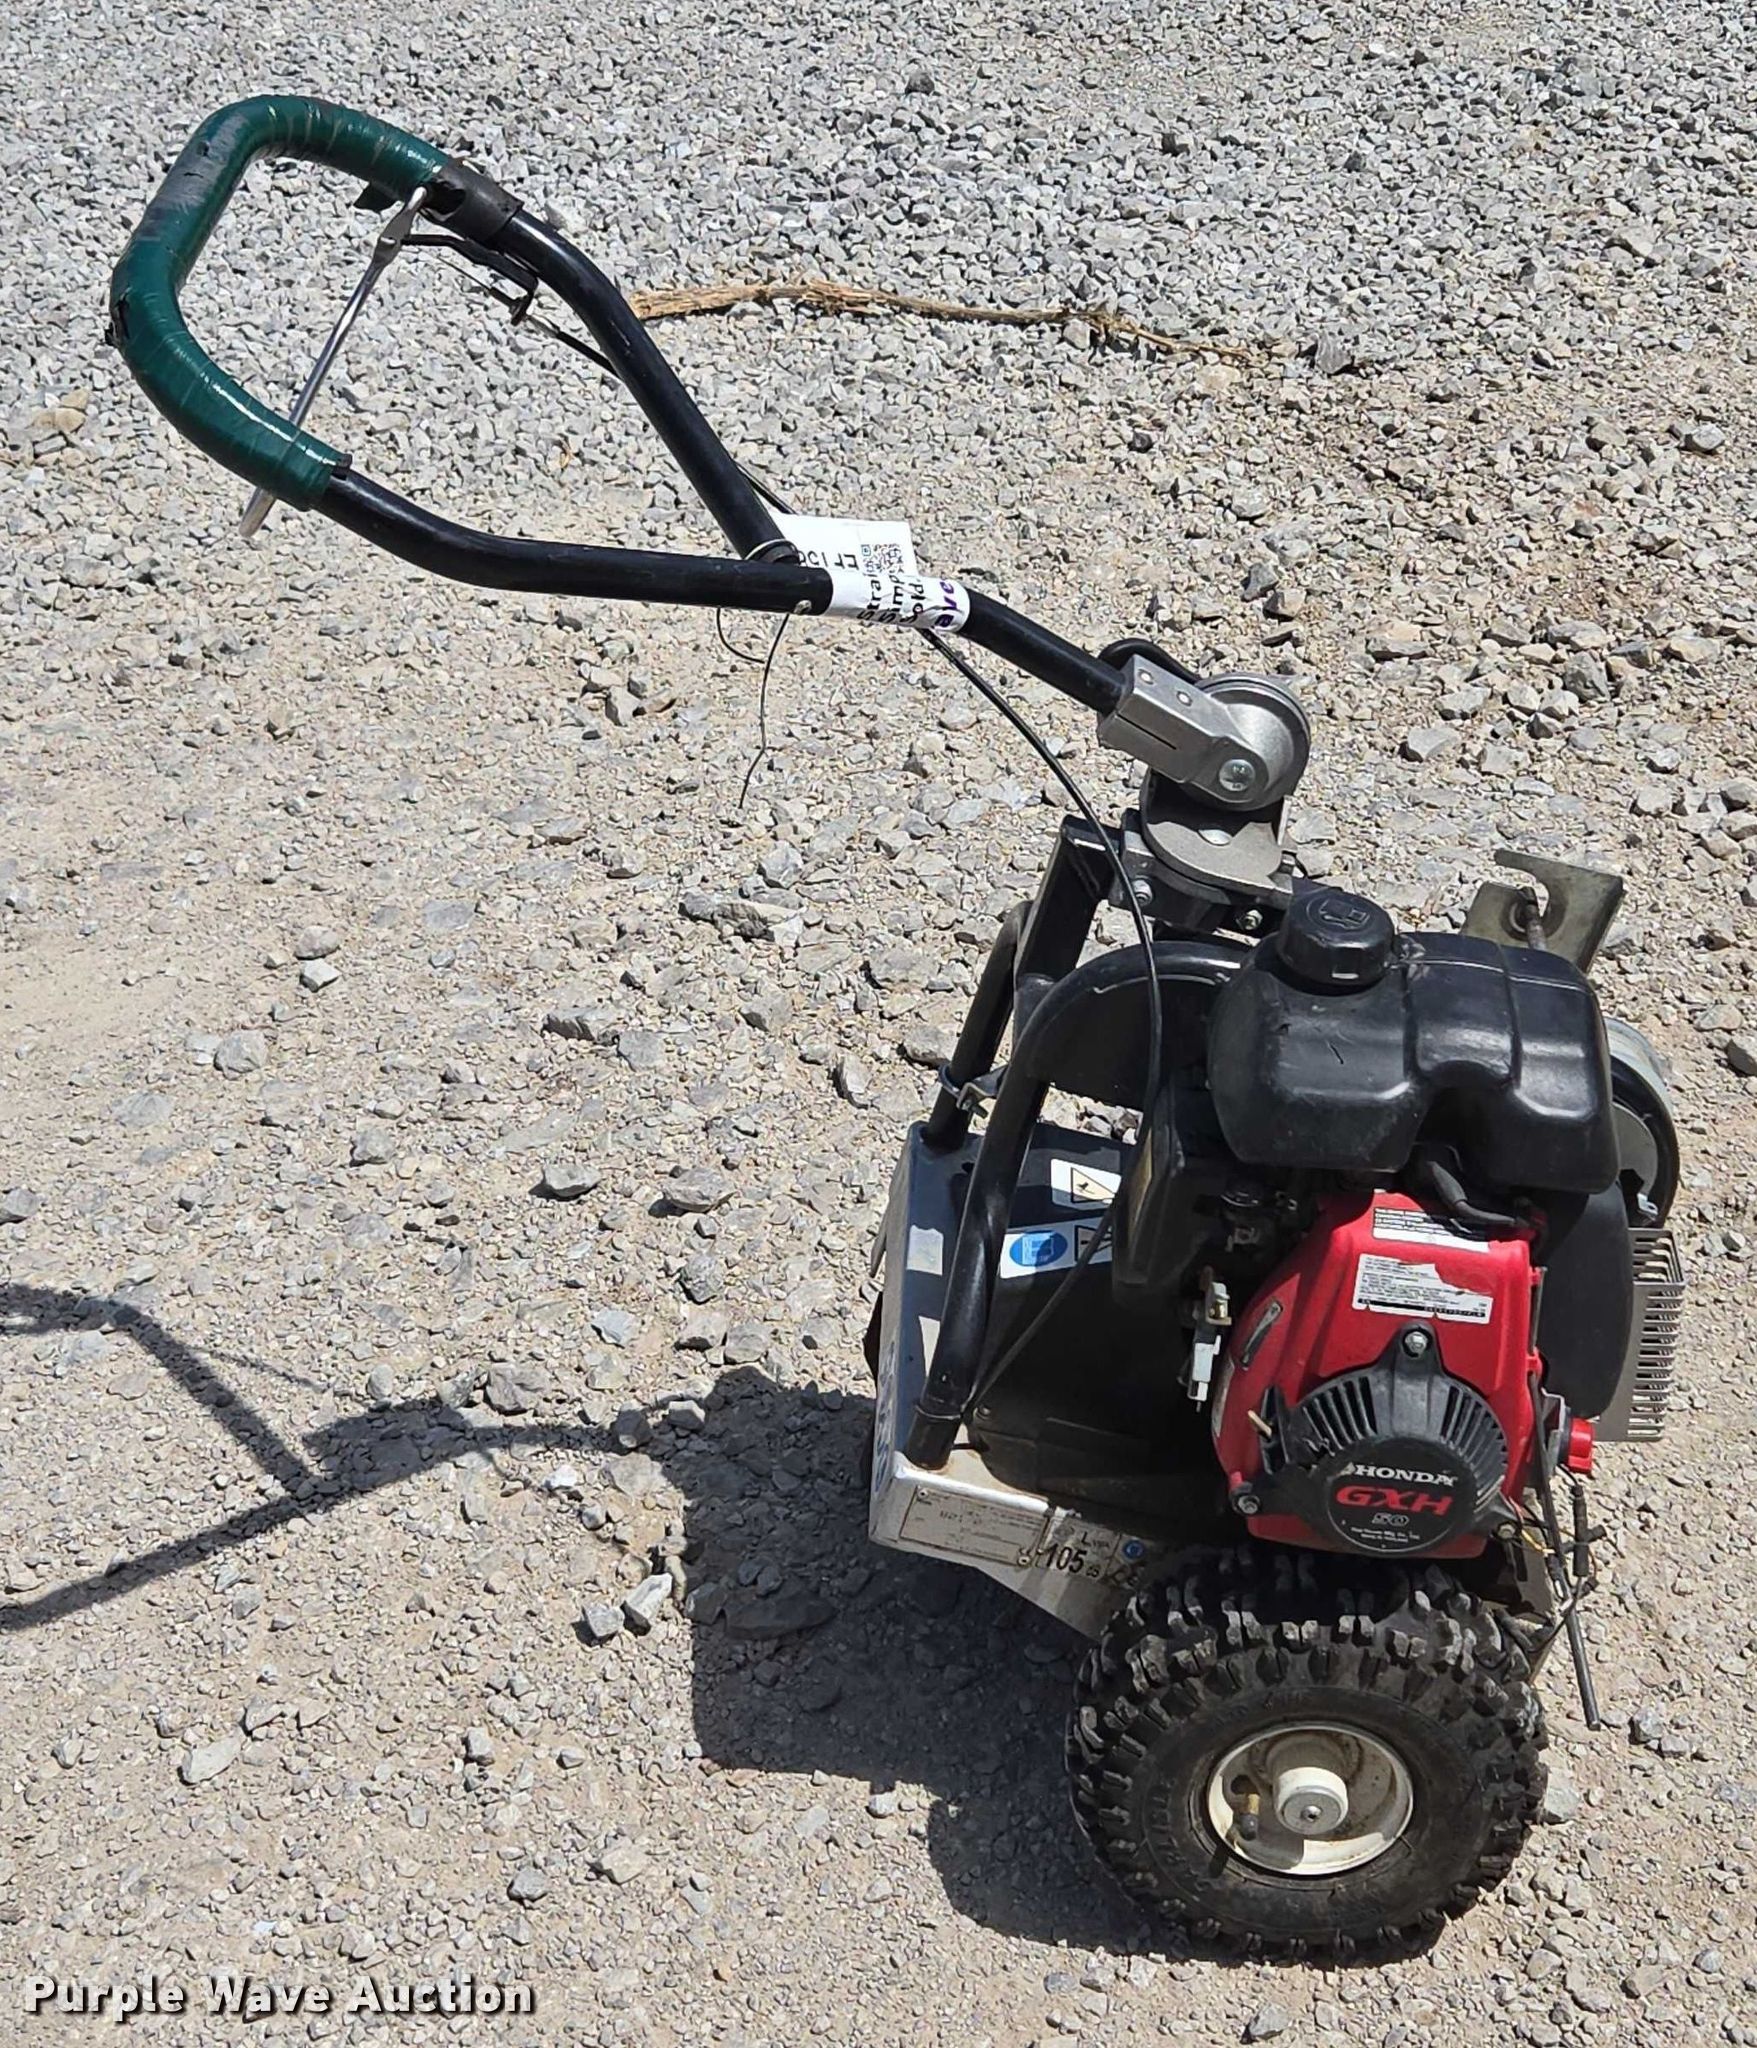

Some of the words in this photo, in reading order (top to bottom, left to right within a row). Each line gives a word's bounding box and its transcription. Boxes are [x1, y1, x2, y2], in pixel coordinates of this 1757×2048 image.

[934, 581, 957, 628] ave
[1354, 1464, 1457, 1486] HONDA
[1336, 1485, 1454, 1516] GXH
[1045, 1543, 1088, 1574] 105
